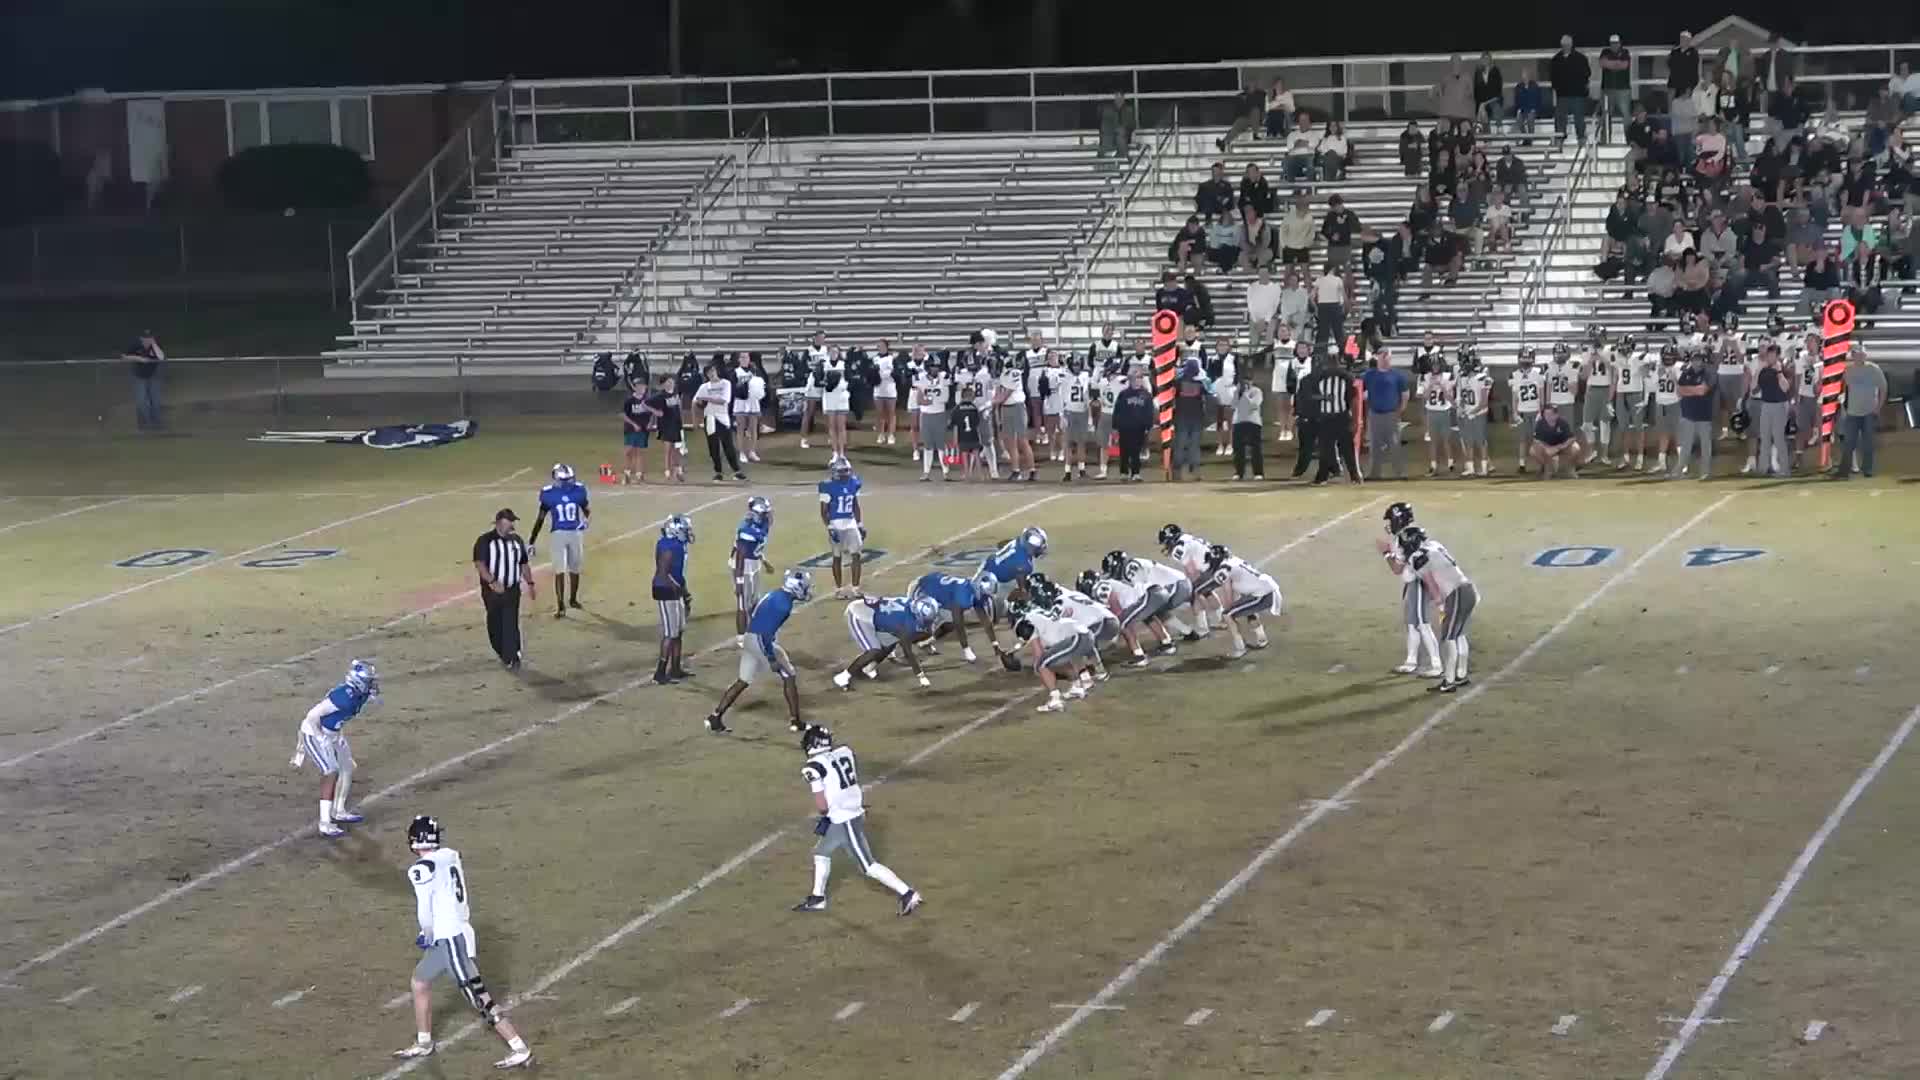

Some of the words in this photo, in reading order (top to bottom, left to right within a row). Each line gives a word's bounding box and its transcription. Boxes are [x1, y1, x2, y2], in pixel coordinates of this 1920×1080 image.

[1071, 385, 1084, 402] 21
[1520, 384, 1537, 402] 23
[963, 416, 972, 432] 1
[556, 503, 576, 522] 10
[836, 494, 854, 513] 12
[831, 756, 856, 790] 12
[413, 869, 421, 881] 3
[450, 866, 465, 903] 3
